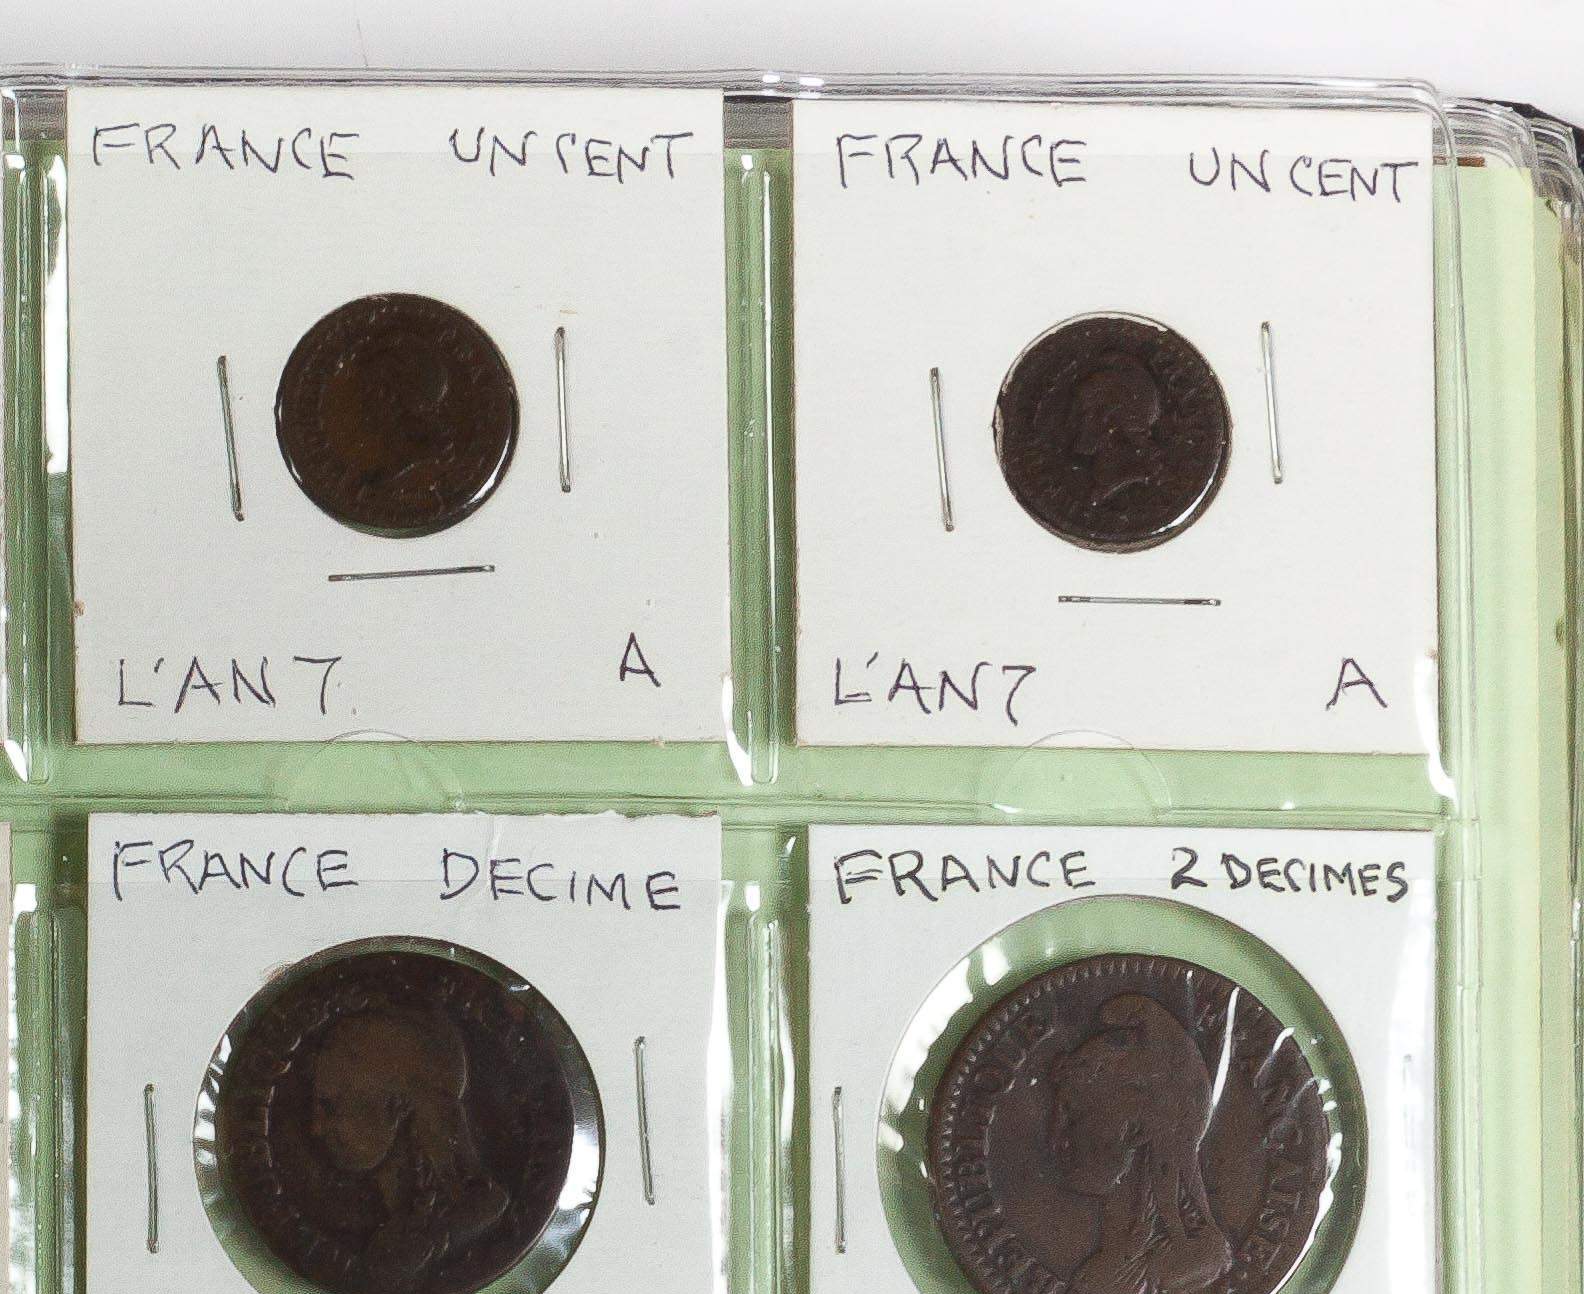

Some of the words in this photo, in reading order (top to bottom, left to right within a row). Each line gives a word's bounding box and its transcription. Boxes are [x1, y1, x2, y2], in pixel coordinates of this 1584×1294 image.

[92, 122, 360, 181] FRANCE
[448, 126, 538, 177] UN
[555, 131, 695, 185] CENT
[835, 133, 1087, 190] FRANCE
[1188, 146, 1272, 194] UN
[1288, 154, 1420, 204] CENT
[618, 631, 662, 688] A
[1325, 657, 1389, 711] A
[112, 838, 360, 902] FRANCE
[439, 847, 682, 912] DECIME
[833, 848, 1097, 911] FRANCE
[1170, 846, 1209, 891] 2
[1219, 851, 1410, 904] DECIMES
